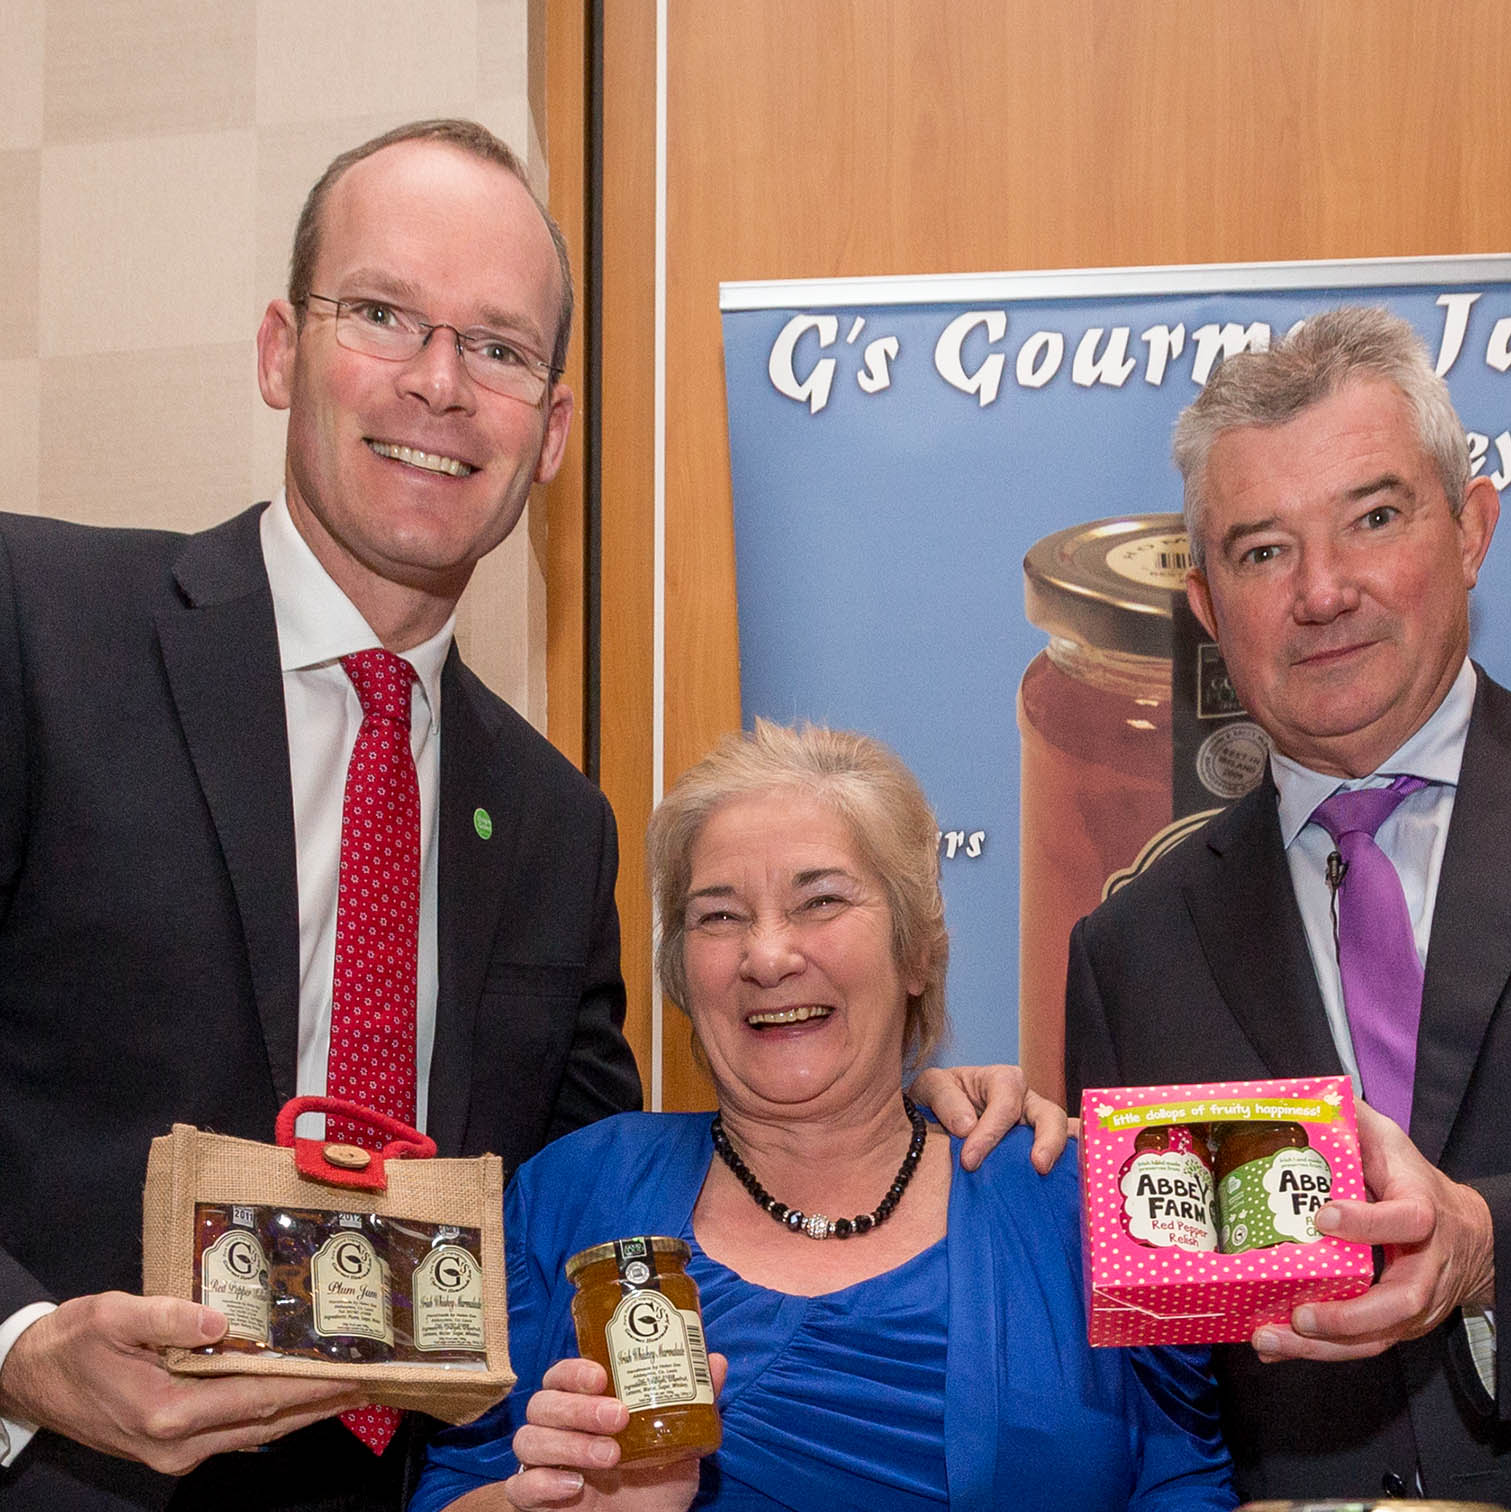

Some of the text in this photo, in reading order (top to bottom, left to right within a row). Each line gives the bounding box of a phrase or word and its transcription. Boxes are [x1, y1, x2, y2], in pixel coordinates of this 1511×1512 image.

[767, 313, 898, 413] G's
[935, 310, 1305, 406] Gourm
[1113, 1115, 1141, 1126] little
[1192, 1105, 1205, 1115] of
[1209, 1104, 1250, 1118] fruity
[1256, 1104, 1320, 1118] happiness!
[1137, 1174, 1209, 1204] ABBEY
[1279, 1170, 1330, 1193] ABB
[1148, 1197, 1206, 1224] FARM
[1152, 1221, 1208, 1238] Red Pepper
[1170, 1233, 1199, 1247] Relish
[336, 1243, 369, 1274] G's
[435, 1257, 469, 1287] G's
[327, 1281, 377, 1300] Plum Jam
[629, 1303, 666, 1337] G's
